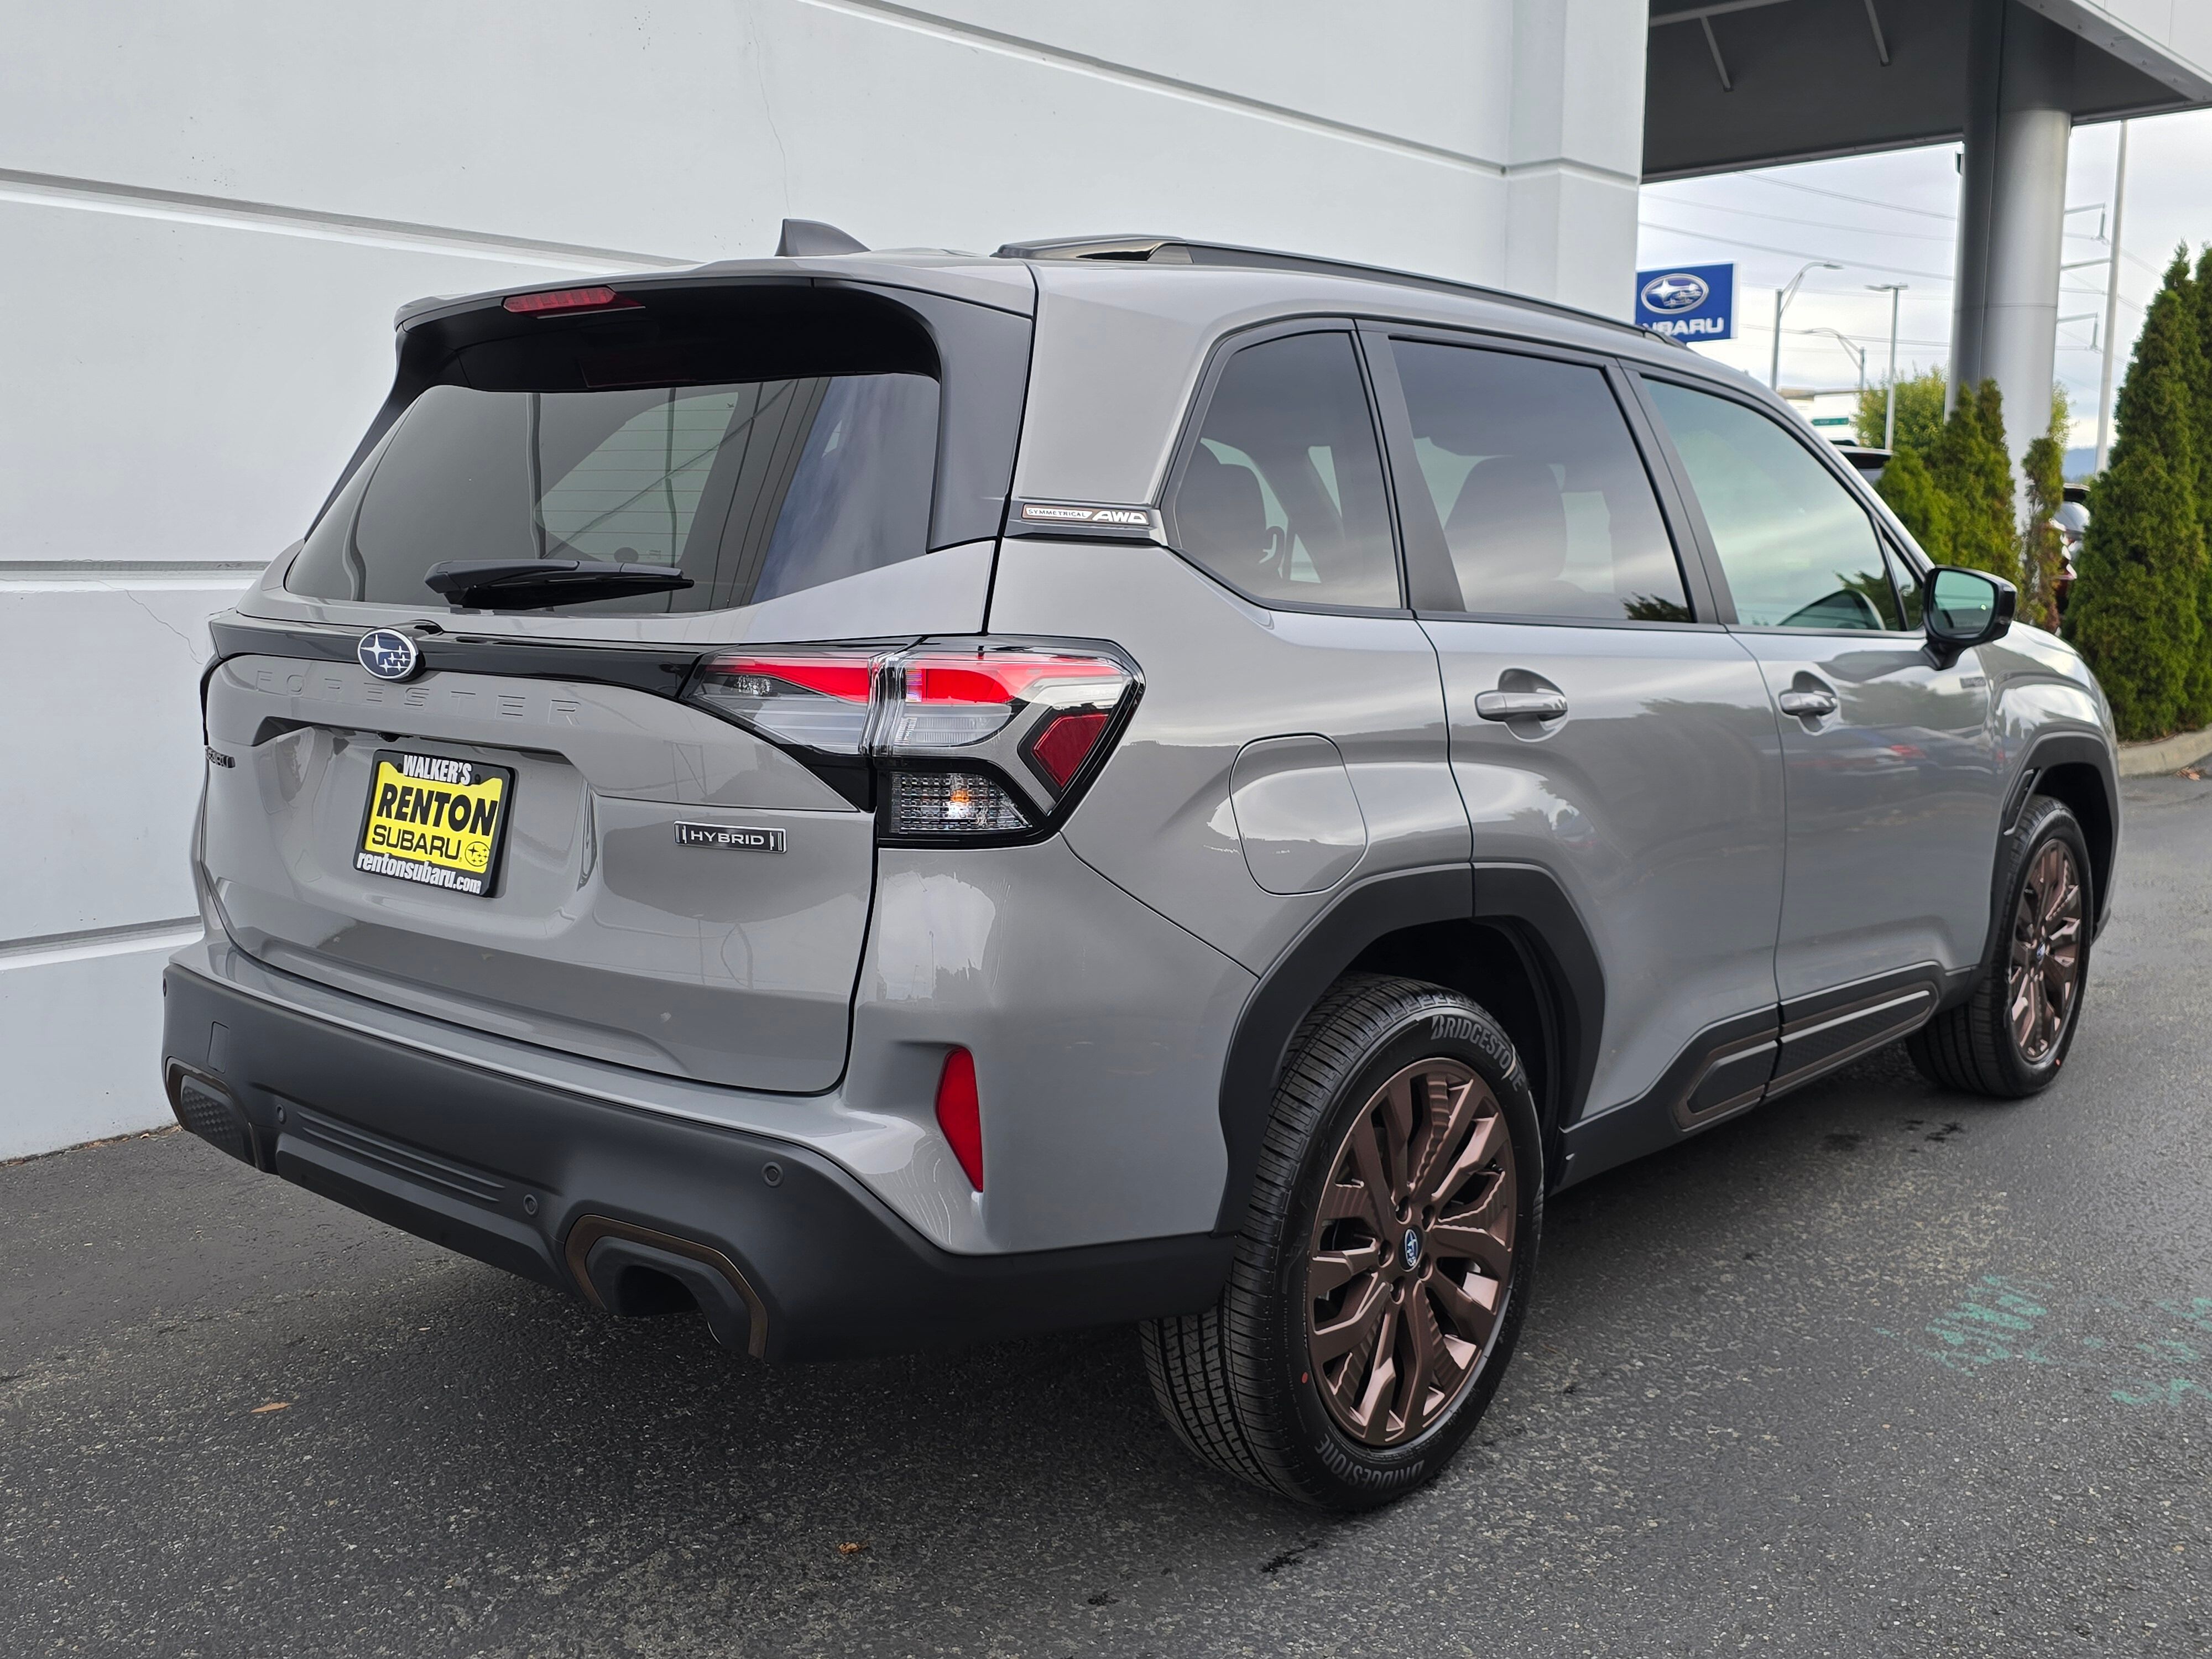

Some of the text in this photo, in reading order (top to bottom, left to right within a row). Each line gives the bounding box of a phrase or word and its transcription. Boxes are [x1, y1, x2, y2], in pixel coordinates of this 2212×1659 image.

[1642, 317, 1724, 336] BARU
[1029, 509, 1146, 523] SYMMETRICAL AWD
[256, 670, 580, 725] FORESTER
[403, 754, 472, 785] WALKER'S
[377, 782, 498, 836] RENTON
[372, 824, 461, 860] SUBARU
[691, 831, 764, 845] HYBRID
[357, 852, 482, 894] rentonsubaru.com
